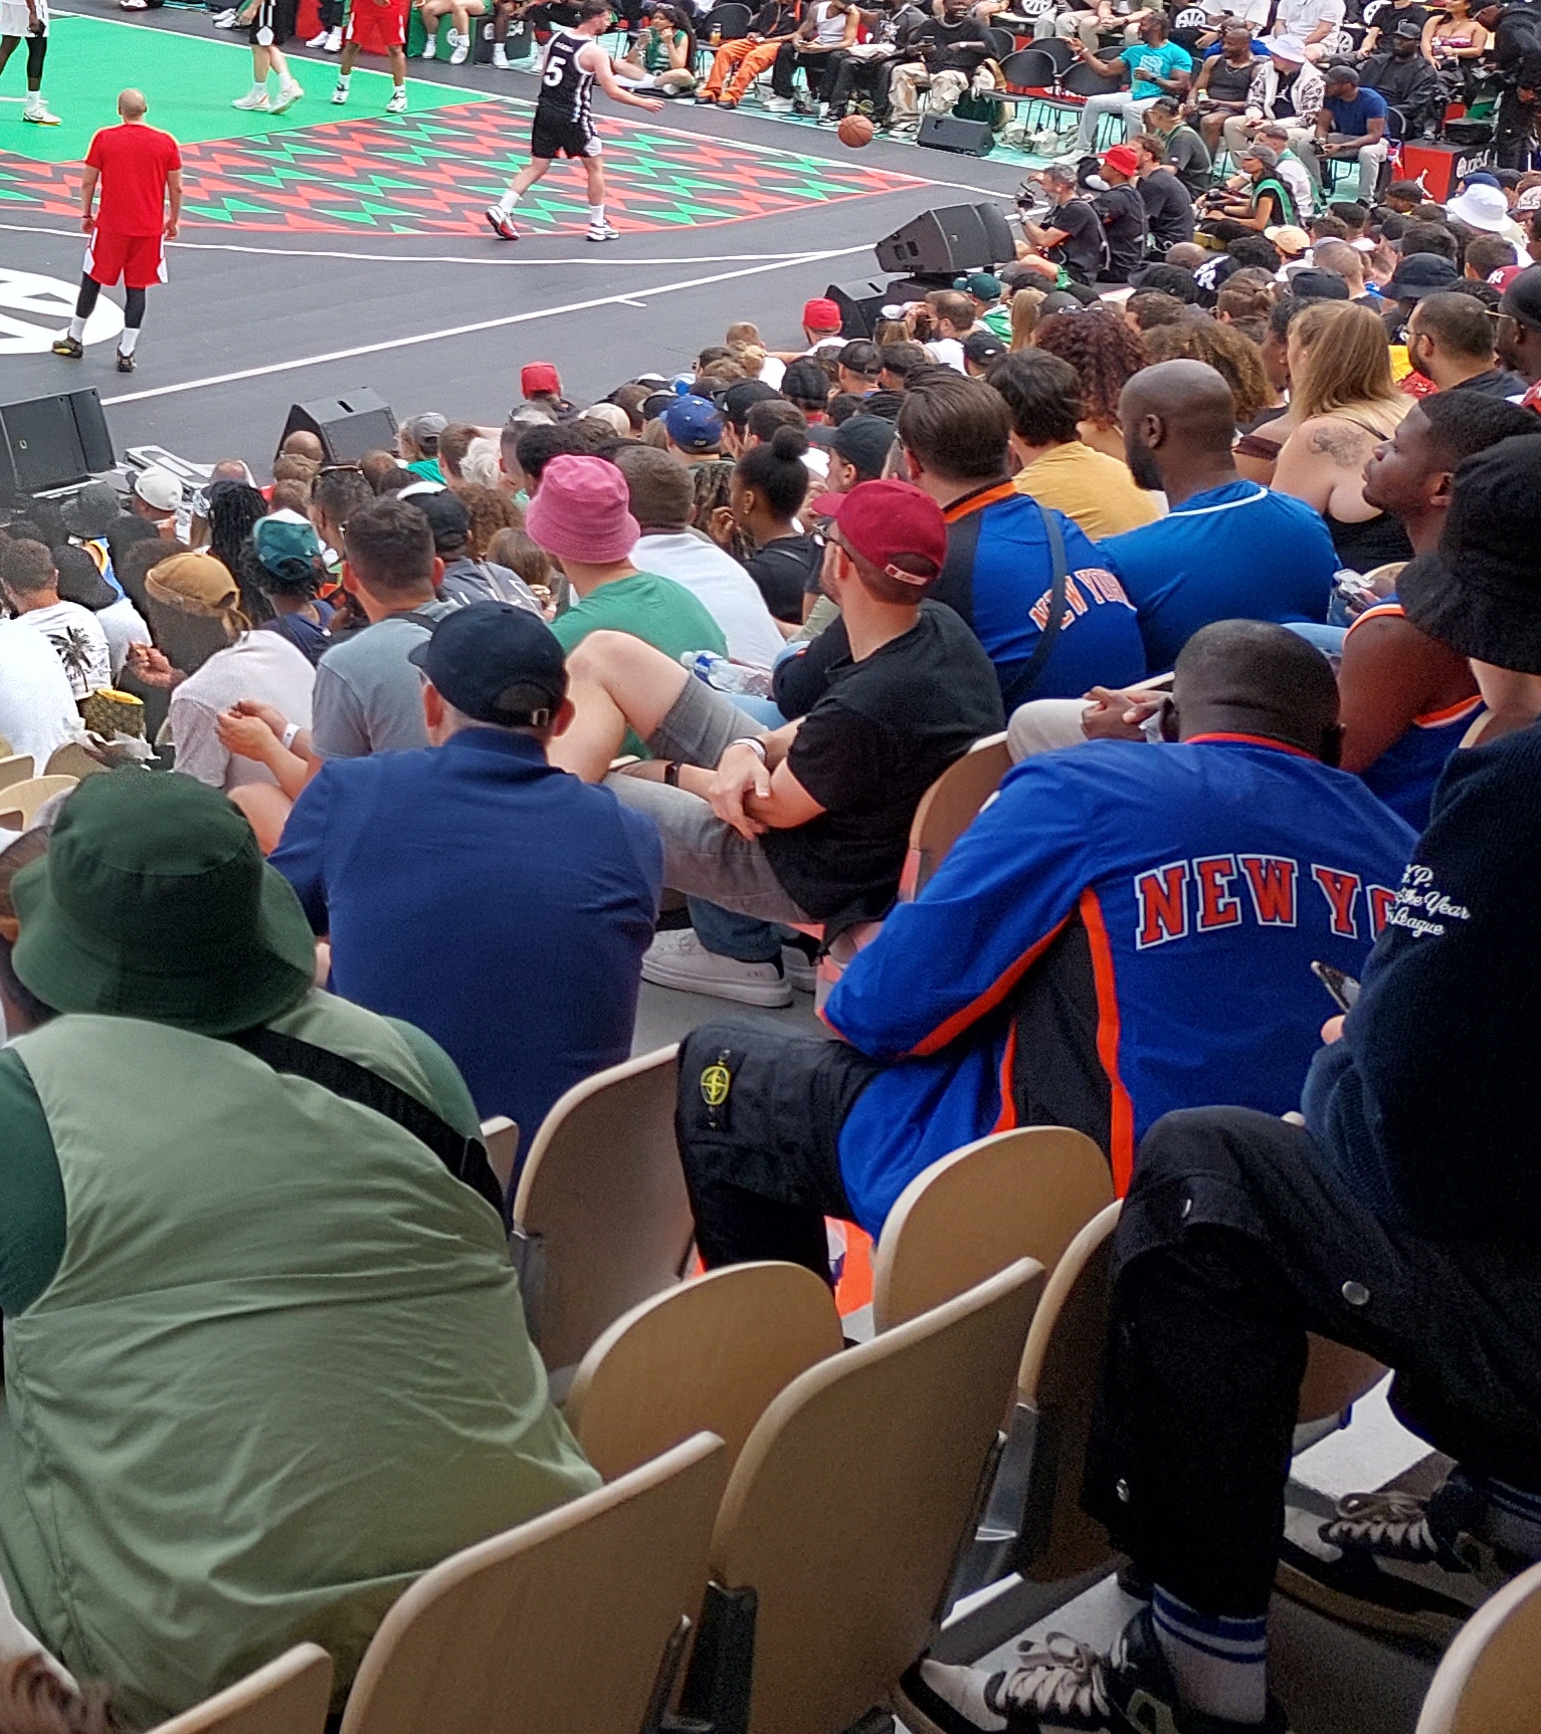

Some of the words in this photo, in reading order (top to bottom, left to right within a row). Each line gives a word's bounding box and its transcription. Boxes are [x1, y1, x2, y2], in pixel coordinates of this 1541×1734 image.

[543, 55, 566, 87] 5
[1134, 853, 1298, 950] NEW
[1424, 891, 1471, 920] Year
[1390, 906, 1444, 938] League
